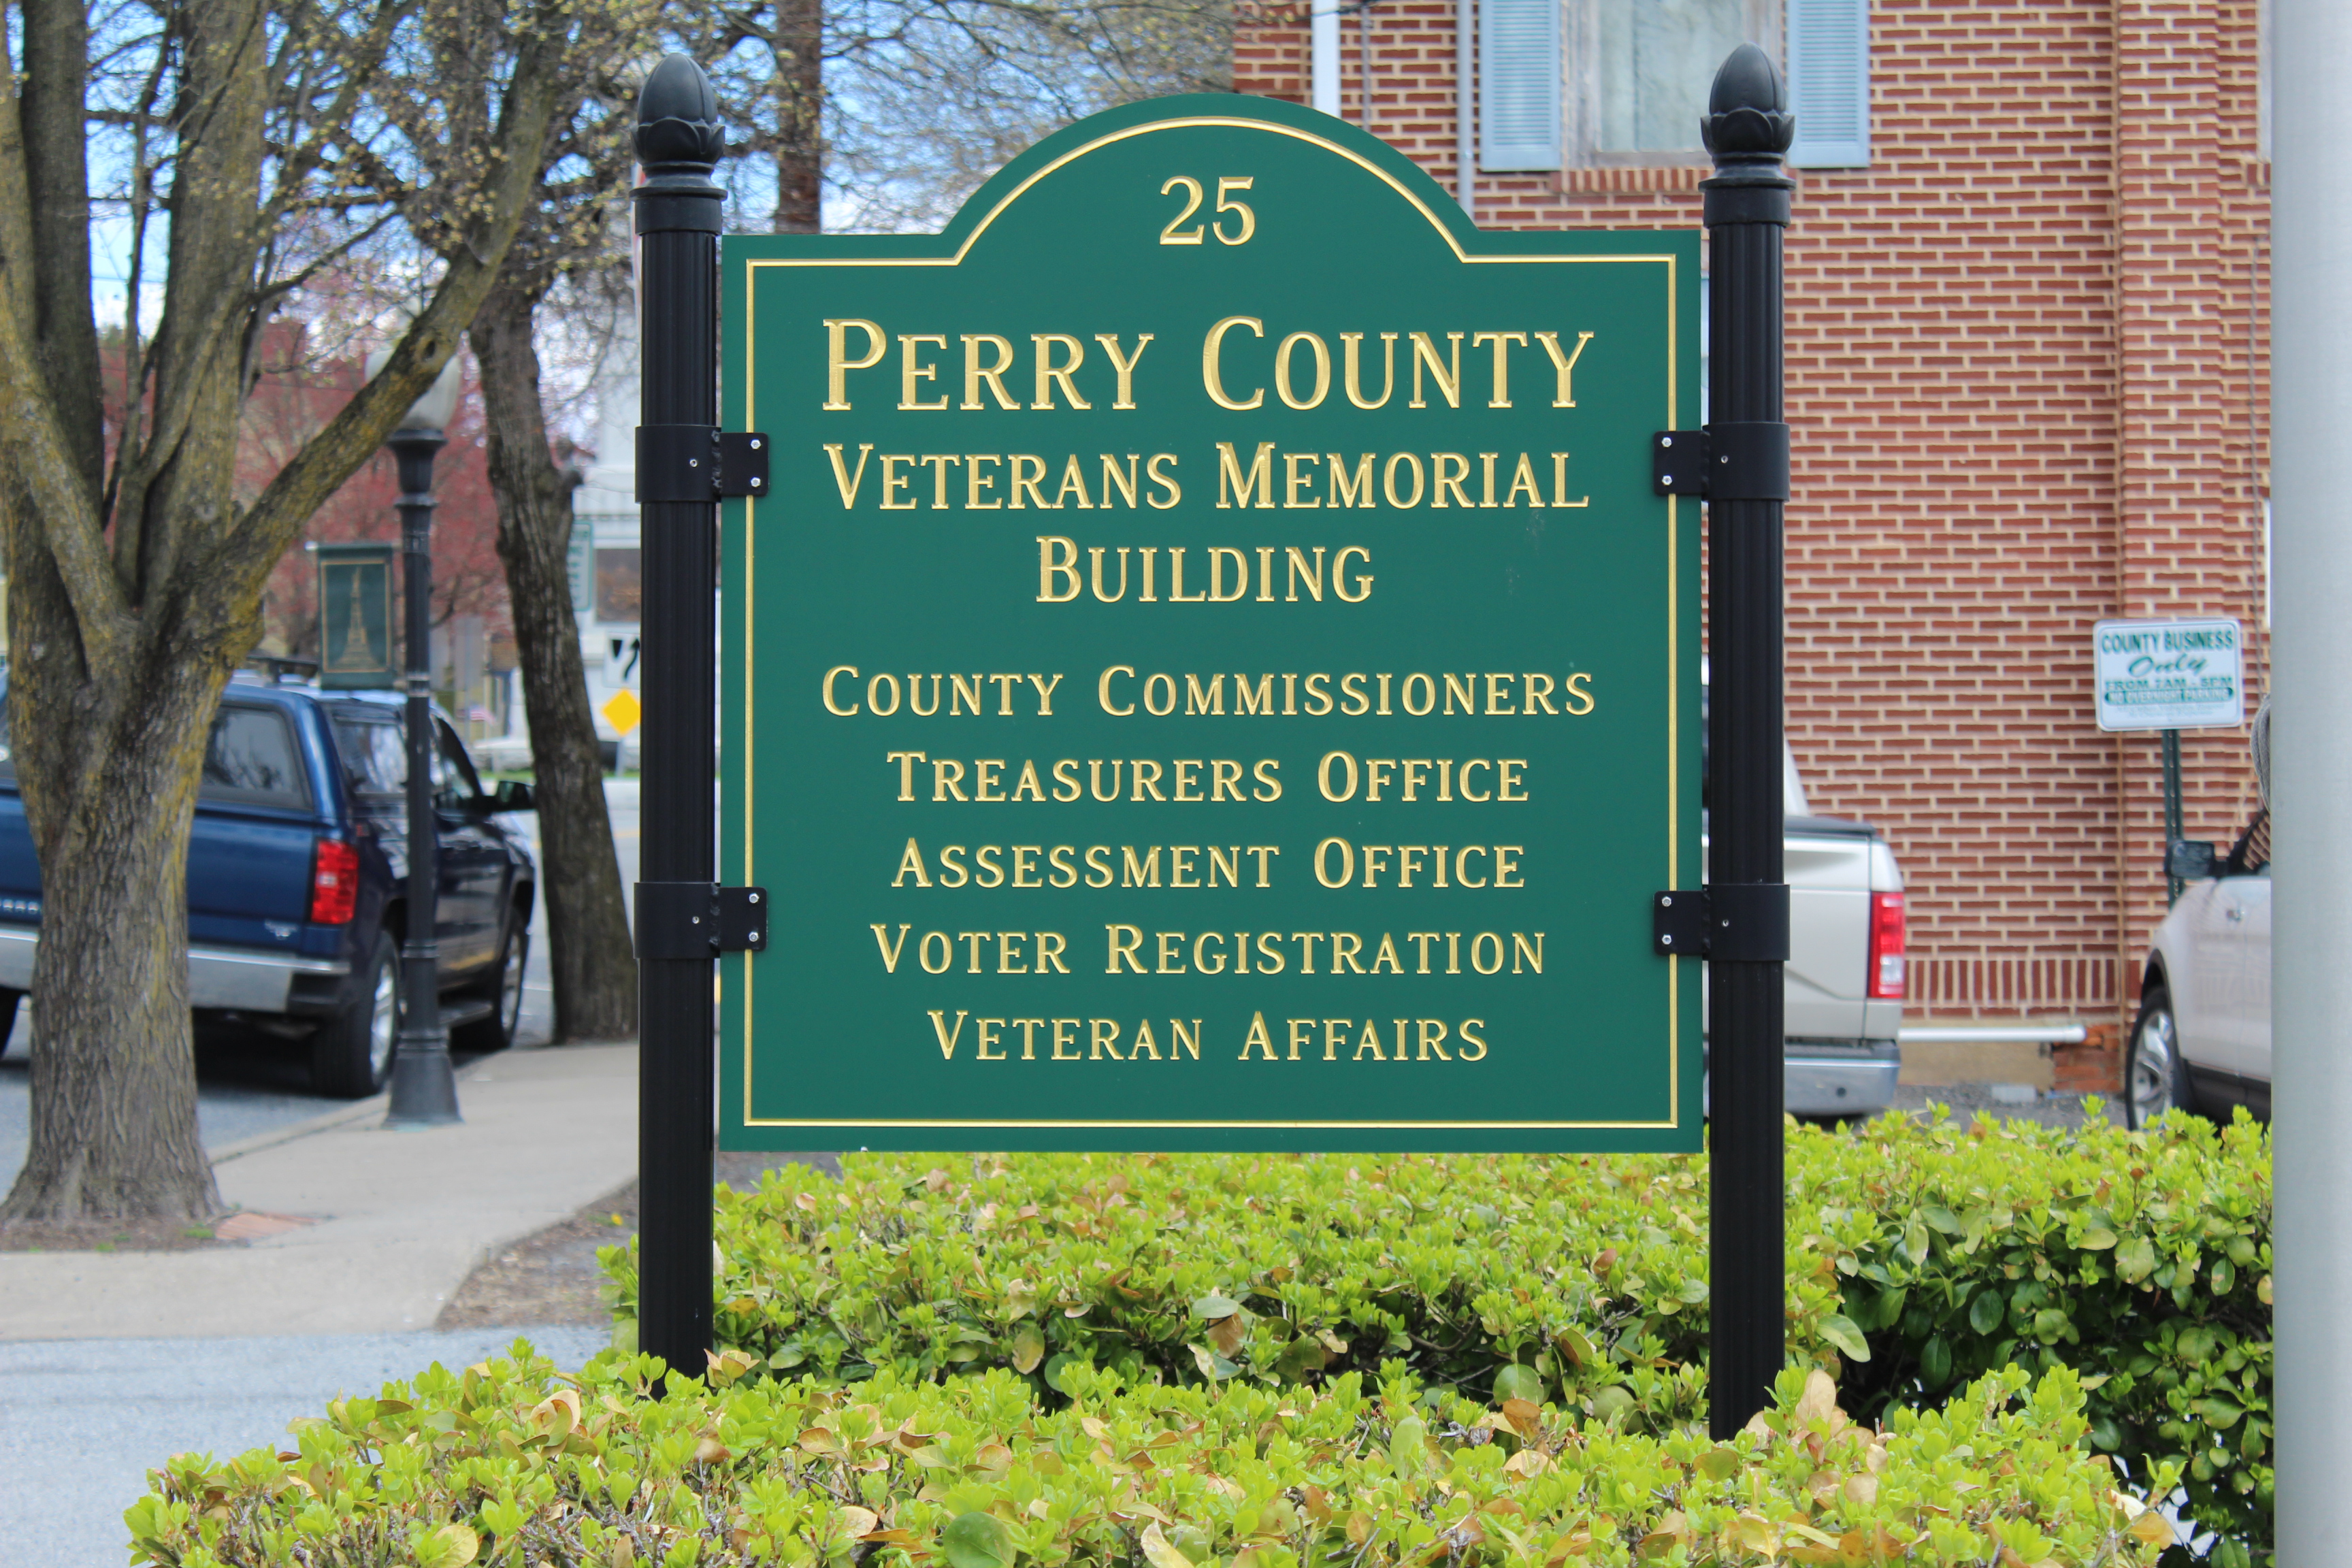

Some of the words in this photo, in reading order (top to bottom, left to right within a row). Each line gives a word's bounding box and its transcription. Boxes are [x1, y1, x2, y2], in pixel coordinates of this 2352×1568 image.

[1159, 175, 1256, 248] 25
[823, 318, 1155, 411] PERRY
[1203, 316, 1595, 411] COUNTY
[823, 443, 1181, 510] VETERANS
[1216, 442, 1590, 510] MEMORIAL
[1036, 536, 1375, 603] BUILDING
[2102, 633, 2159, 653] COUNTY
[2165, 630, 2234, 651] BUSINESS
[2129, 653, 2206, 676] Only
[822, 665, 1064, 717] COUNTY
[1098, 665, 1595, 717] COMMISSIONERS
[2106, 681, 2149, 691] FROM
[2155, 679, 2186, 689] 7AM
[2109, 691, 2124, 703] NO
[2126, 690, 2182, 702] OVERNIGHT
[2185, 688, 2230, 700] PARKING
[887, 751, 1283, 802] TREASURERS
[1318, 751, 1529, 802] OFFICE
[892, 838, 1280, 889] ASSESSMENT
[1314, 837, 1525, 888] OFFICE
[870, 924, 1071, 975] VOTER
[1105, 924, 1546, 975] REGISTRATION
[928, 1010, 1203, 1060] VETERAN
[1238, 1011, 1488, 1061] AFFAIRS
